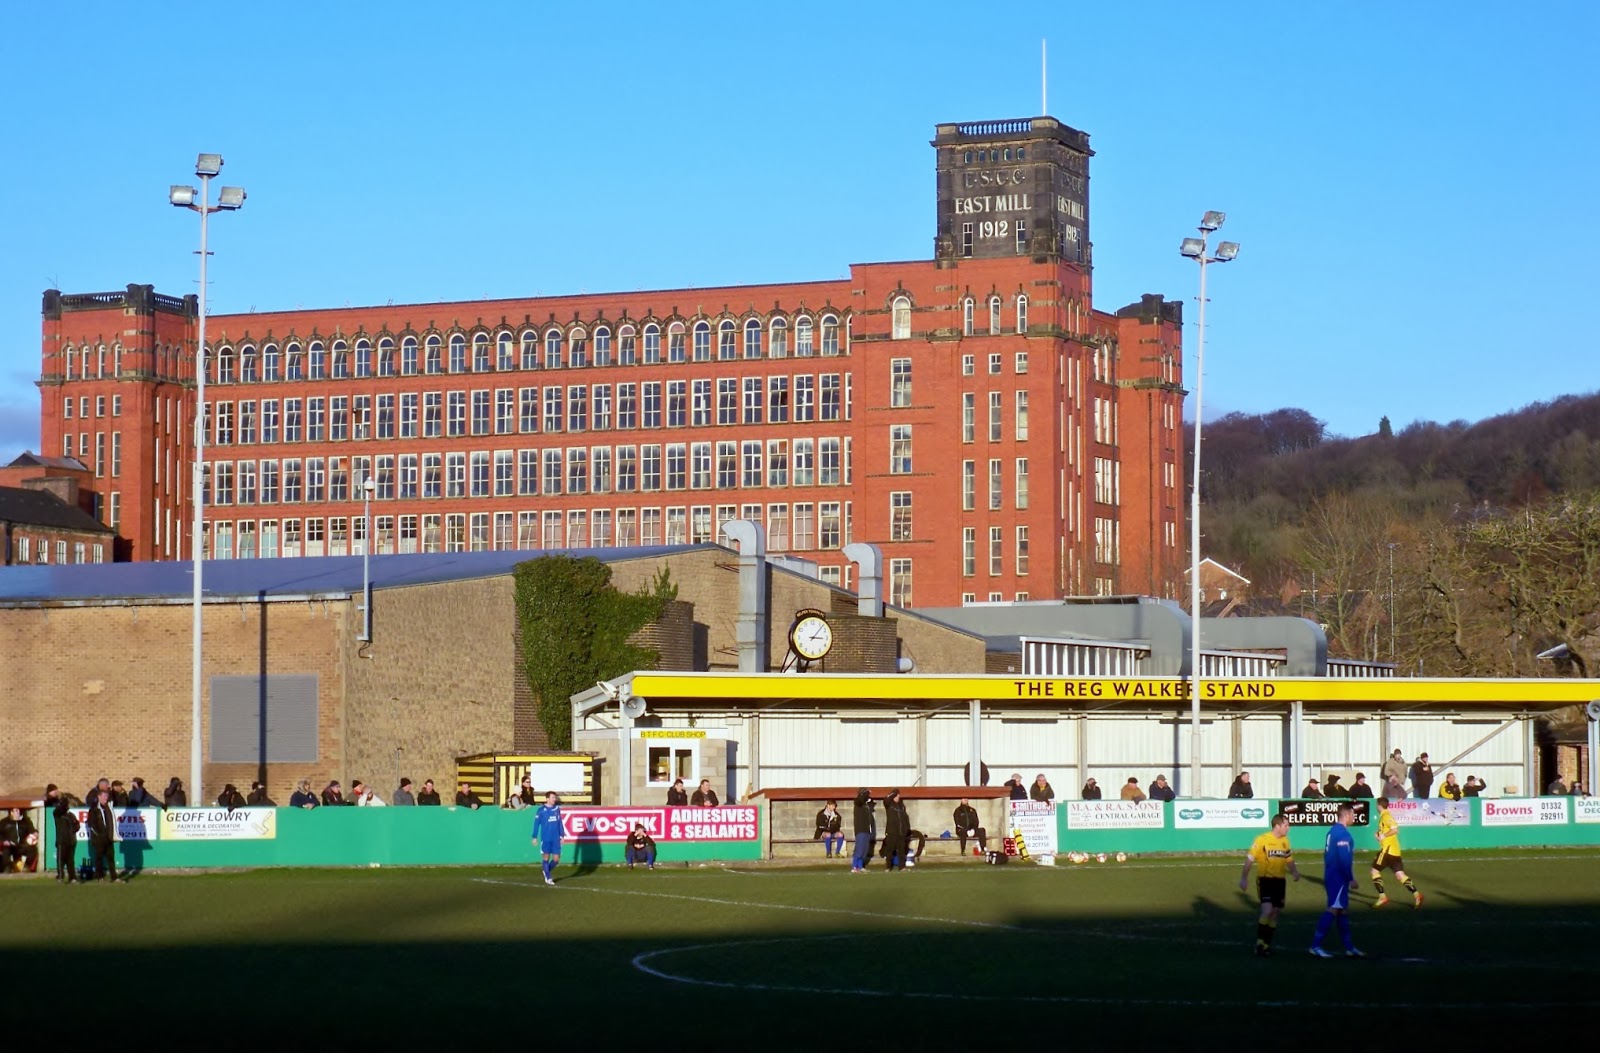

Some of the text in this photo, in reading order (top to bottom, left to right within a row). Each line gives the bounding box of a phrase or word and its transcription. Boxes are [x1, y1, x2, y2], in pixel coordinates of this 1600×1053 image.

[954, 193, 1032, 215] EAST MILL
[1057, 195, 1085, 221] EAST MILL
[979, 220, 1009, 239] 1912
[1065, 224, 1077, 242] 1912
[1014, 682, 1054, 696] THE
[1065, 682, 1103, 696] REG
[1206, 683, 1275, 697] STAND
[1070, 804, 1092, 812] M.A.
[1094, 804, 1102, 812] &
[1106, 803, 1124, 811] R.A.
[1486, 803, 1533, 815] Browns
[1541, 802, 1562, 810] 01332
[166, 811, 252, 822] GEOFF LOWRY
[670, 808, 755, 823] ADHESIVES
[1322, 814, 1338, 823] TO
[1540, 812, 1564, 820] 292911
[670, 824, 755, 839] & SEALANTS
